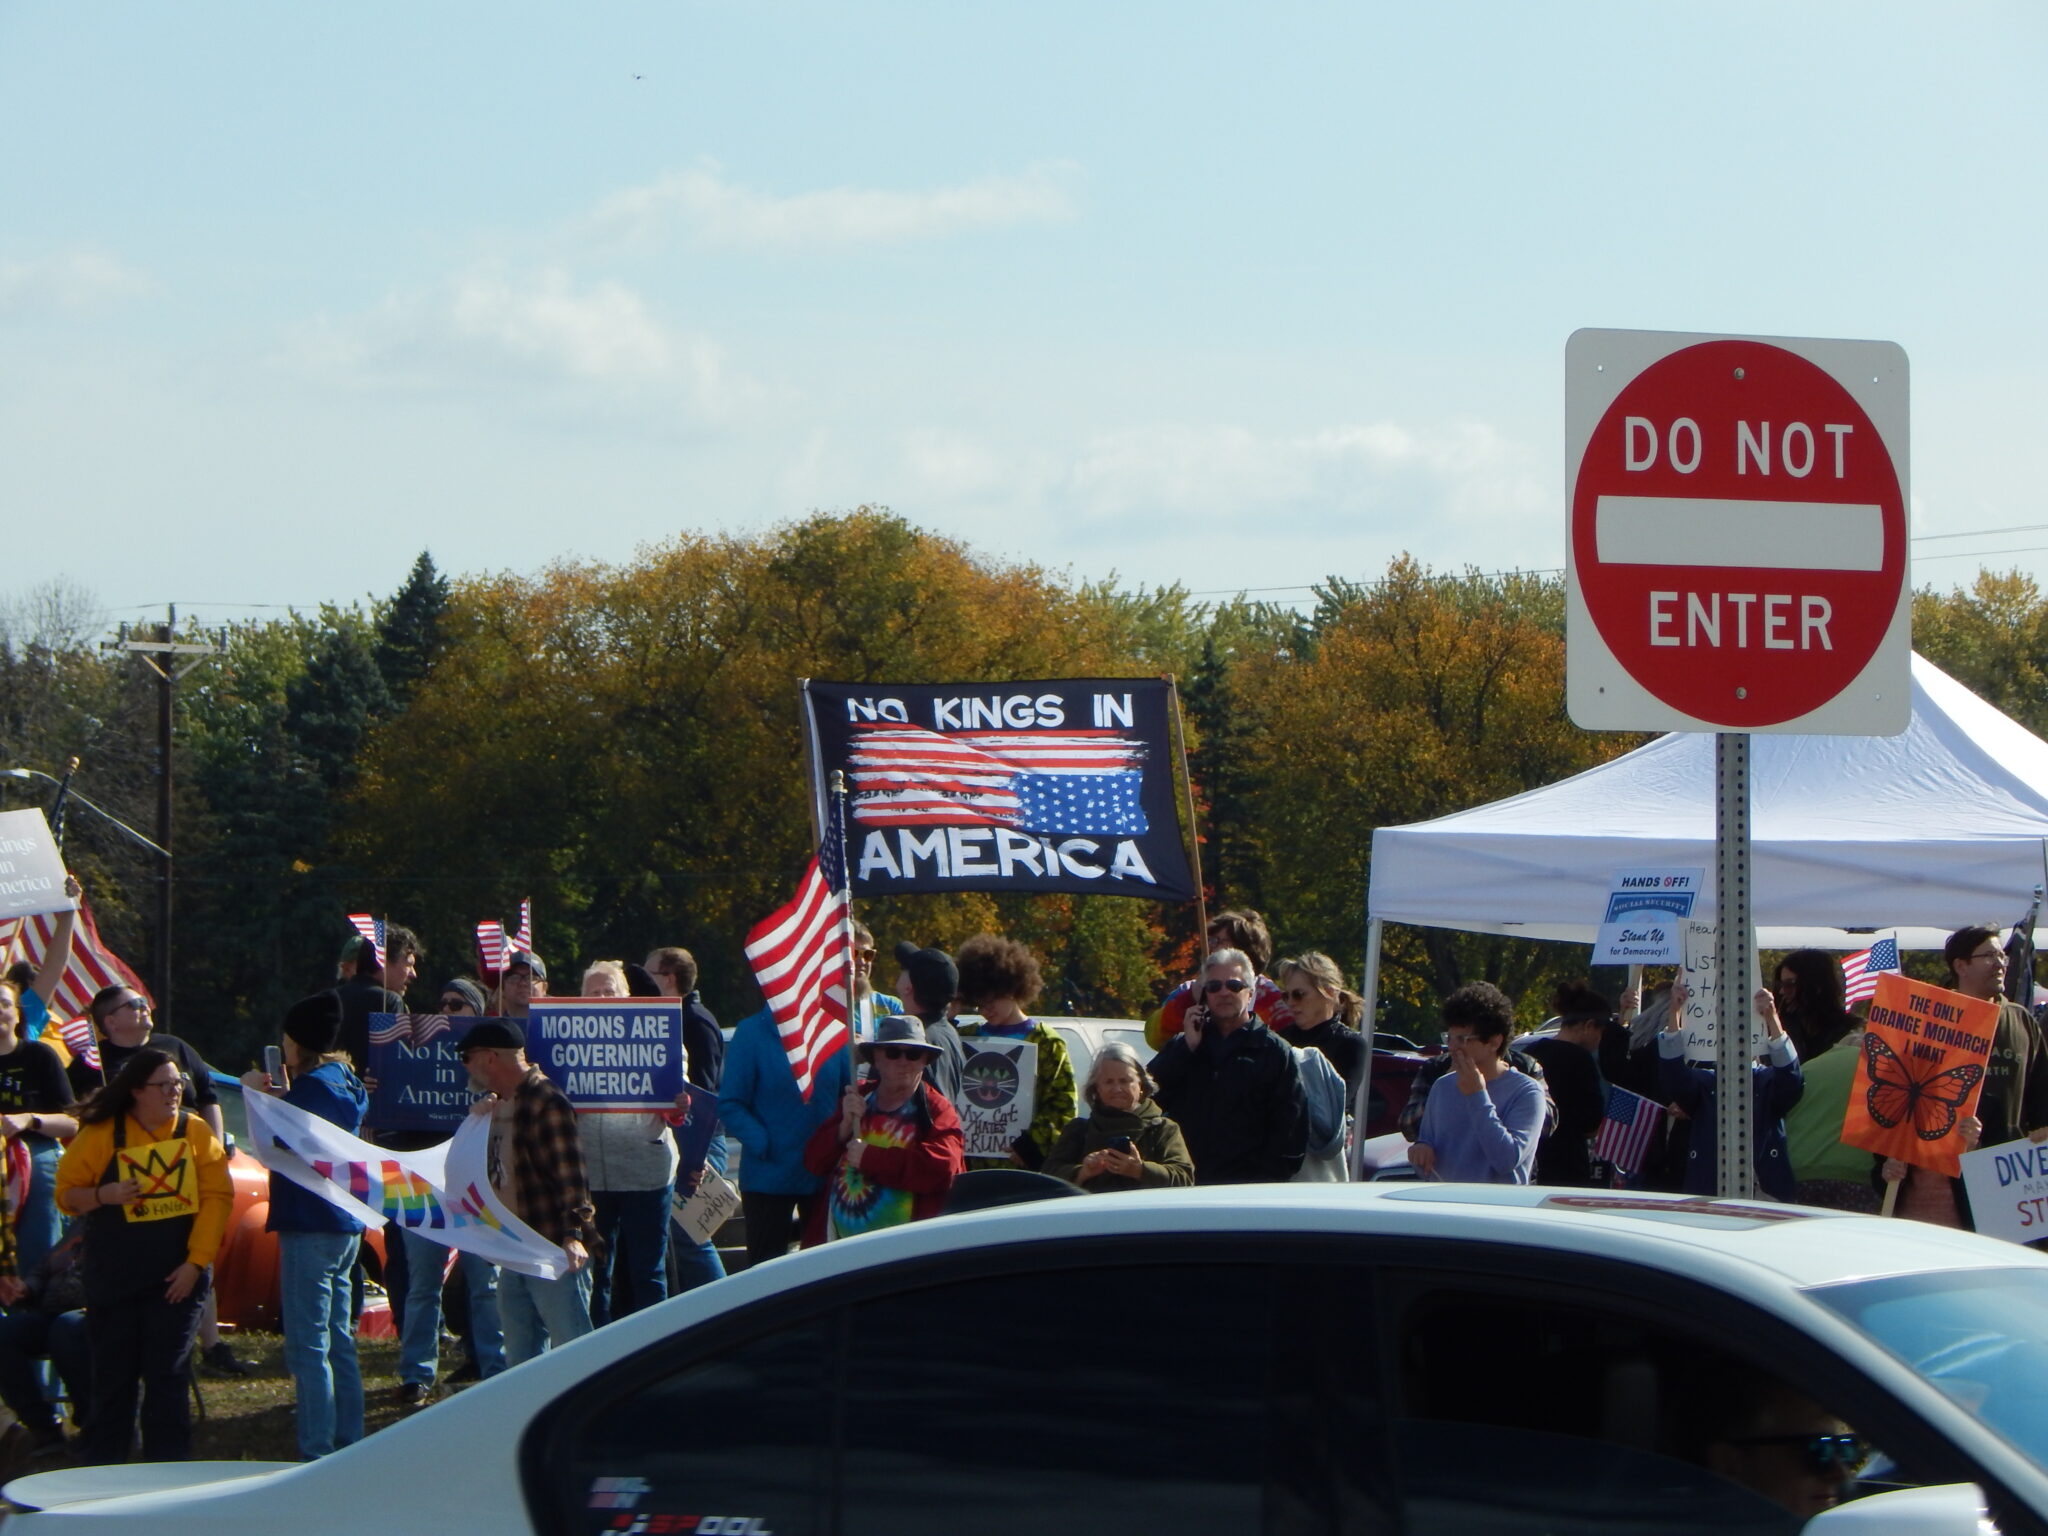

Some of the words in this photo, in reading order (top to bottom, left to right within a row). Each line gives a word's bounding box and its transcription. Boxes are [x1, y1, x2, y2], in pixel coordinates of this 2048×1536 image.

[1625, 416, 1702, 474] DO
[1737, 420, 1853, 479] NOT
[1650, 591, 1833, 651] ENTER
[847, 697, 909, 724] NO
[933, 694, 1065, 730] KINGS
[1093, 693, 1134, 728] IN
[0, 836, 38, 856] ings
[857, 827, 1157, 885] AMERICA
[0, 876, 52, 895] merica
[1621, 876, 1661, 888] HANDS
[1619, 928, 1648, 943] Stand
[1650, 928, 1665, 944] Up
[1610, 946, 1621, 955] for
[1622, 946, 1670, 957] Democracy!!
[1908, 994, 1931, 1015] THE
[1933, 1002, 1964, 1024] ONLY
[541, 1016, 625, 1039] MORONS
[631, 1016, 670, 1039] ARE
[1870, 1005, 1922, 1035] ORANGE
[1924, 1022, 1990, 1056] MONARCH
[398, 1040, 430, 1060] No
[551, 1043, 667, 1067] GOVERNING
[1904, 1039, 1909, 1054] I
[1912, 1043, 1947, 1065] WANT
[436, 1064, 456, 1083] in
[566, 1072, 654, 1095] AMERICA
[398, 1085, 483, 1106] Americ
[974, 1121, 1007, 1135] HATES
[2017, 1197, 2048, 1226] ST
